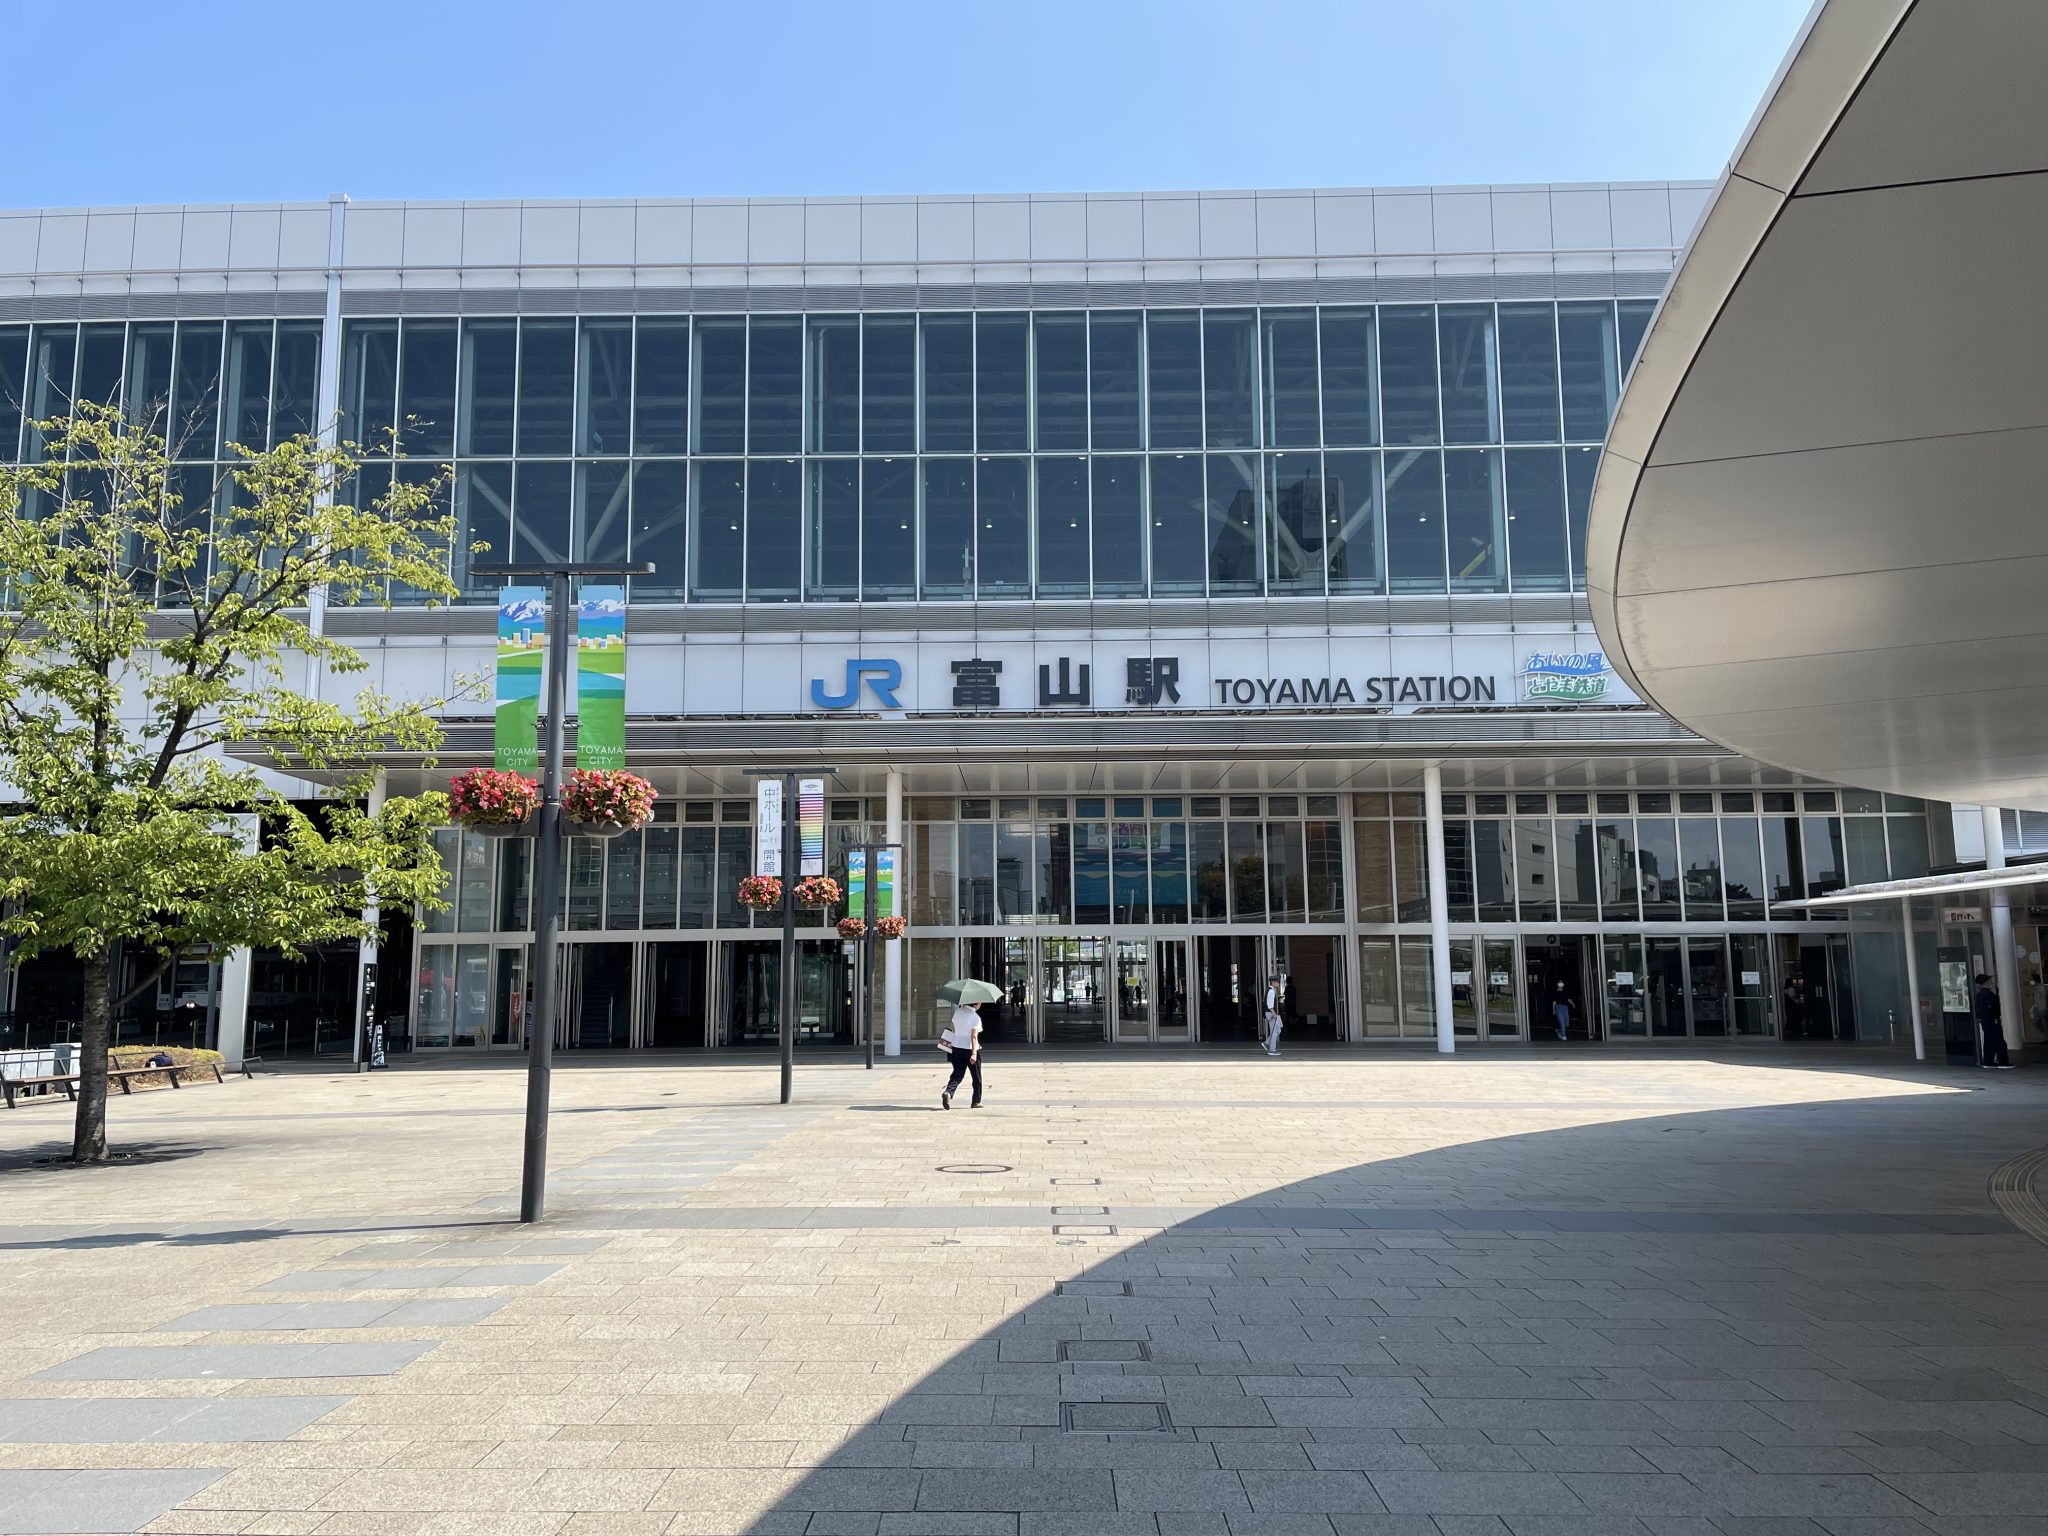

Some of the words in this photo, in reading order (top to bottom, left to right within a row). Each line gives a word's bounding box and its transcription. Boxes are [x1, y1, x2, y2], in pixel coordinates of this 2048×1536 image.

[1524, 652, 1605, 675] あいの風
[811, 658, 902, 708] JR
[950, 657, 1181, 707] 富山駅
[1215, 677, 1356, 705] TOYAMA
[1366, 675, 1497, 702] STATION
[1526, 676, 1608, 698] とやま鉄道
[498, 747, 537, 756] TOYAMA
[581, 745, 624, 755] TOYAMA
[589, 756, 613, 765] CITY
[506, 758, 529, 766] CITY
[764, 787, 776, 832] 中ホール
[764, 849, 775, 872] 開館
